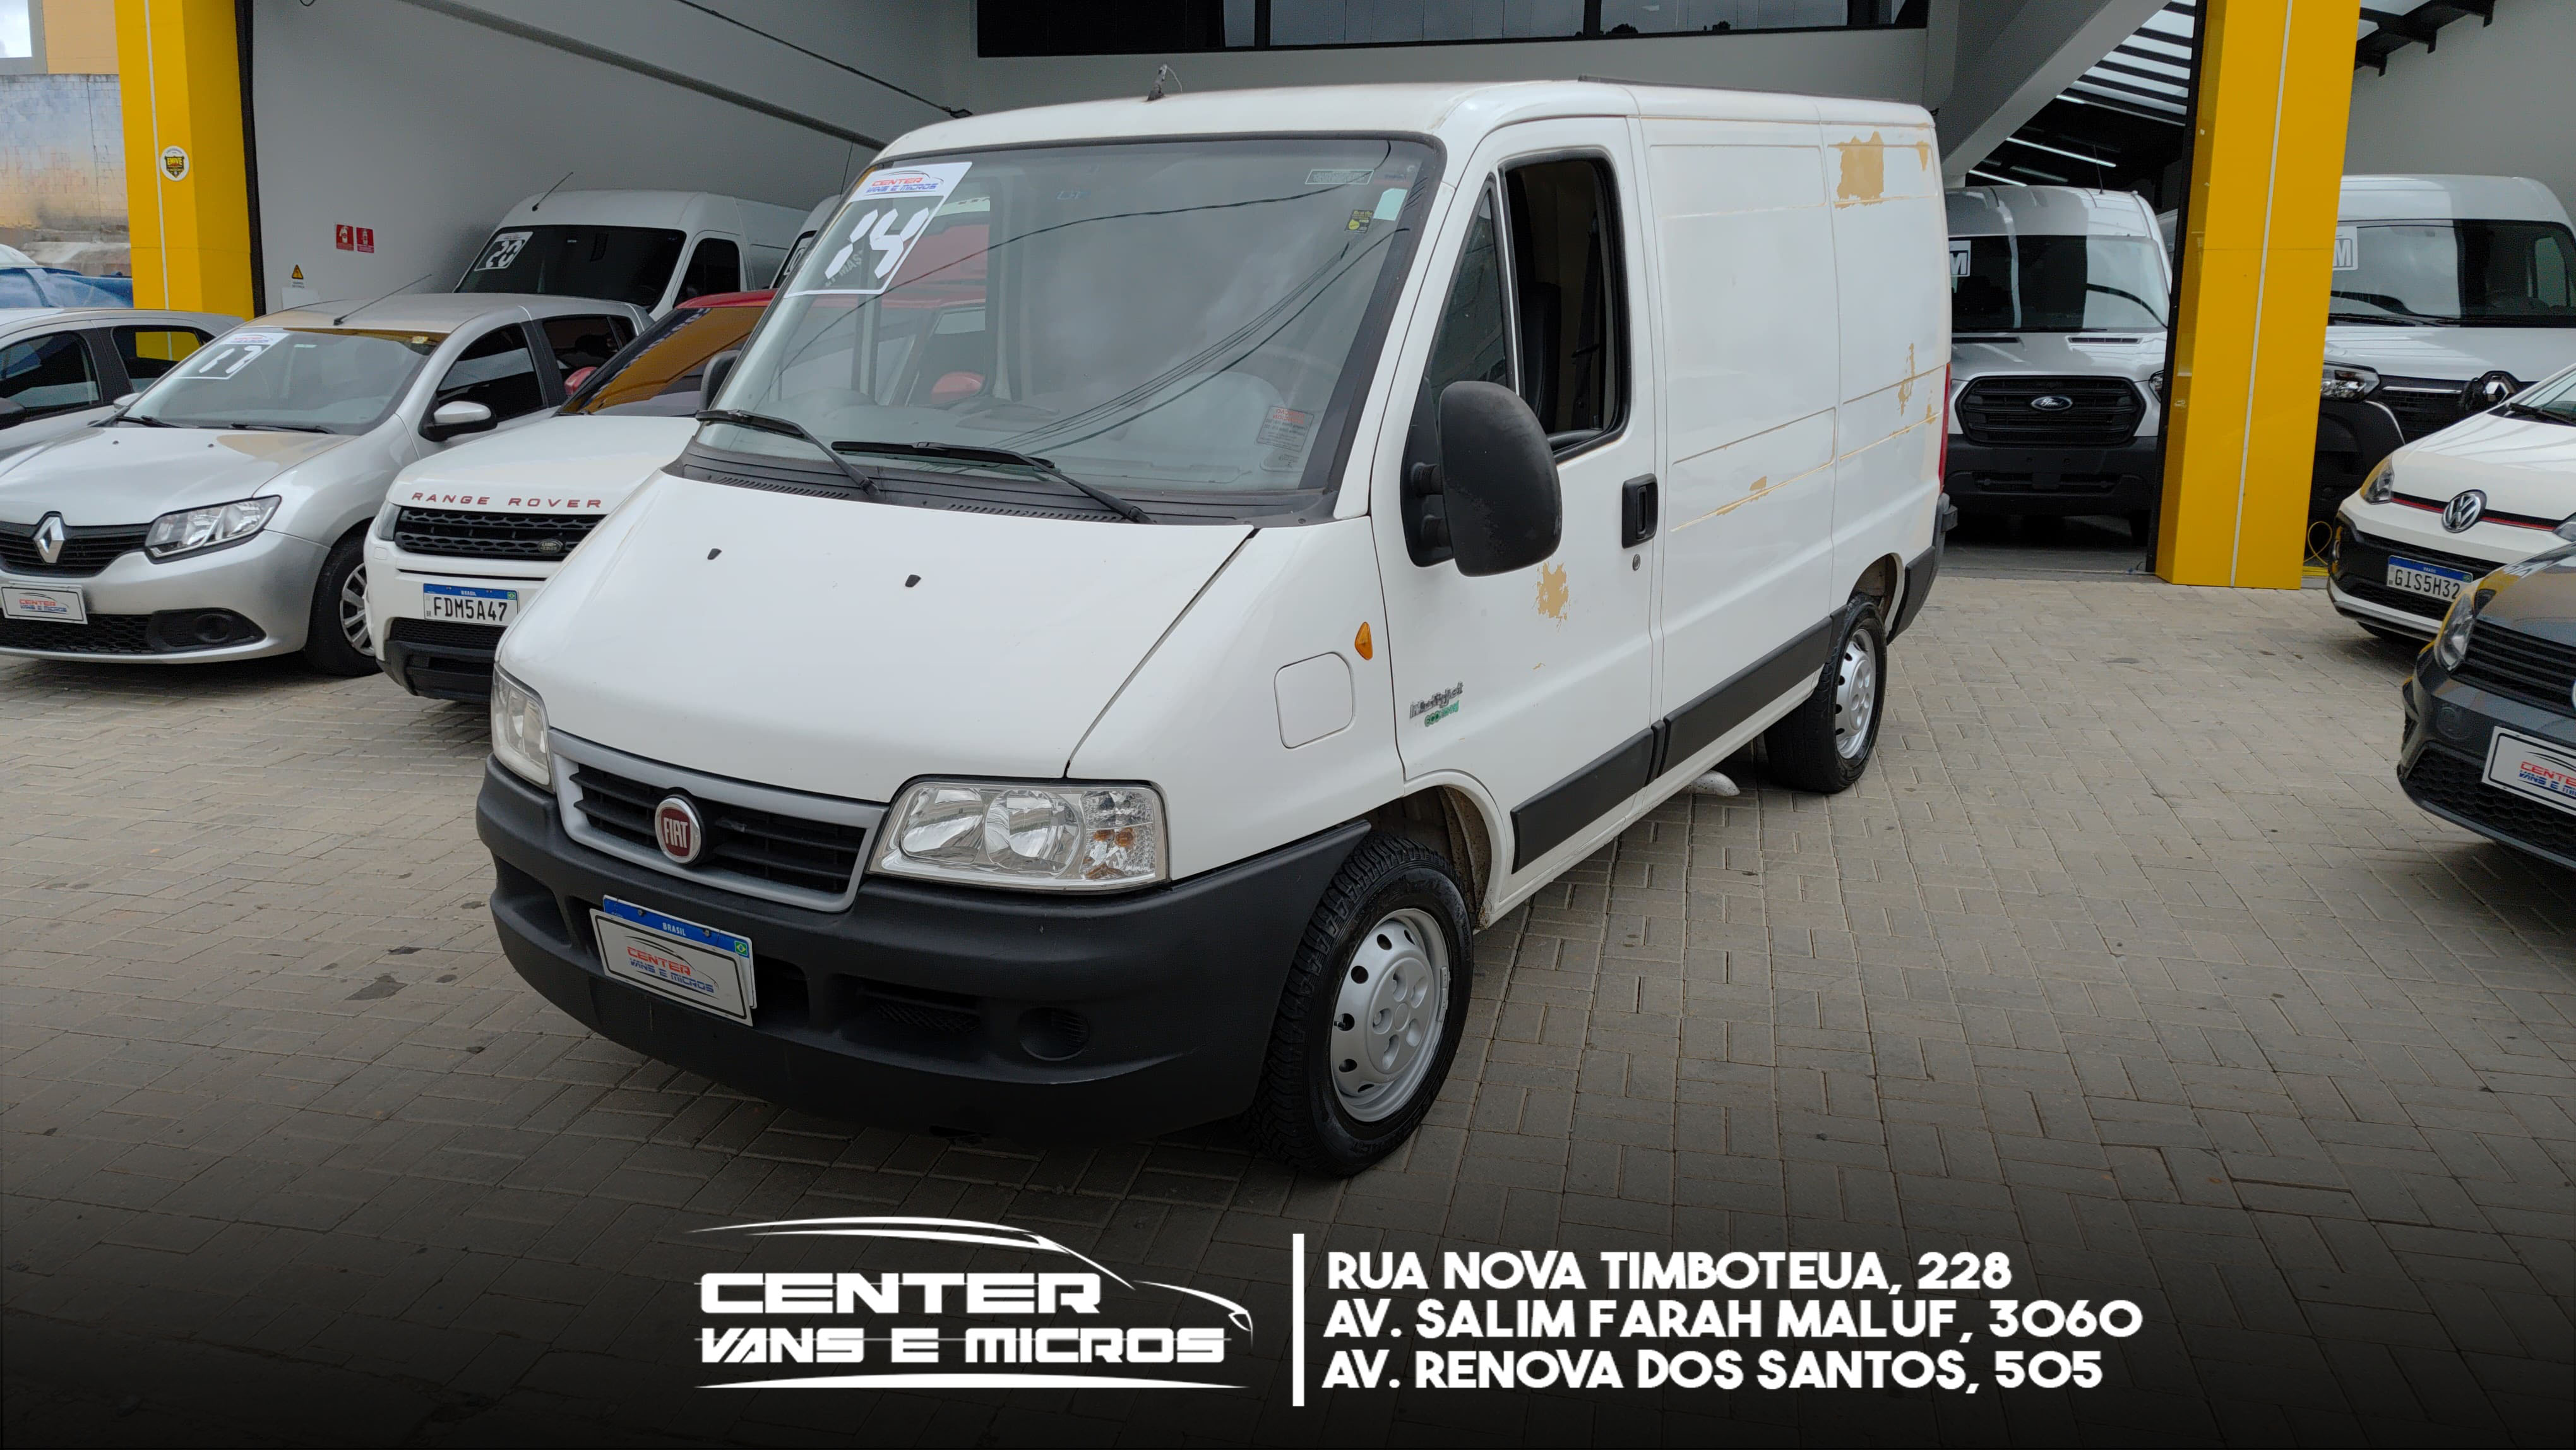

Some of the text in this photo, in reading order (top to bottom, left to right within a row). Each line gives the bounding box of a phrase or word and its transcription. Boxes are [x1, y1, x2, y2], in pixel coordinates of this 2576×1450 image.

[872, 177, 923, 186] CENTER
[486, 240, 522, 268] 20
[412, 492, 602, 508] RANGE ROVER
[2395, 569, 2460, 600] GIS5H32
[434, 597, 507, 621] FDM5A47
[2520, 761, 2576, 787] CENTE
[664, 817, 688, 849] FIAT
[662, 922, 686, 936] BRASIL
[626, 946, 691, 976] CENTER
[629, 957, 714, 993] VANS E MICROS
